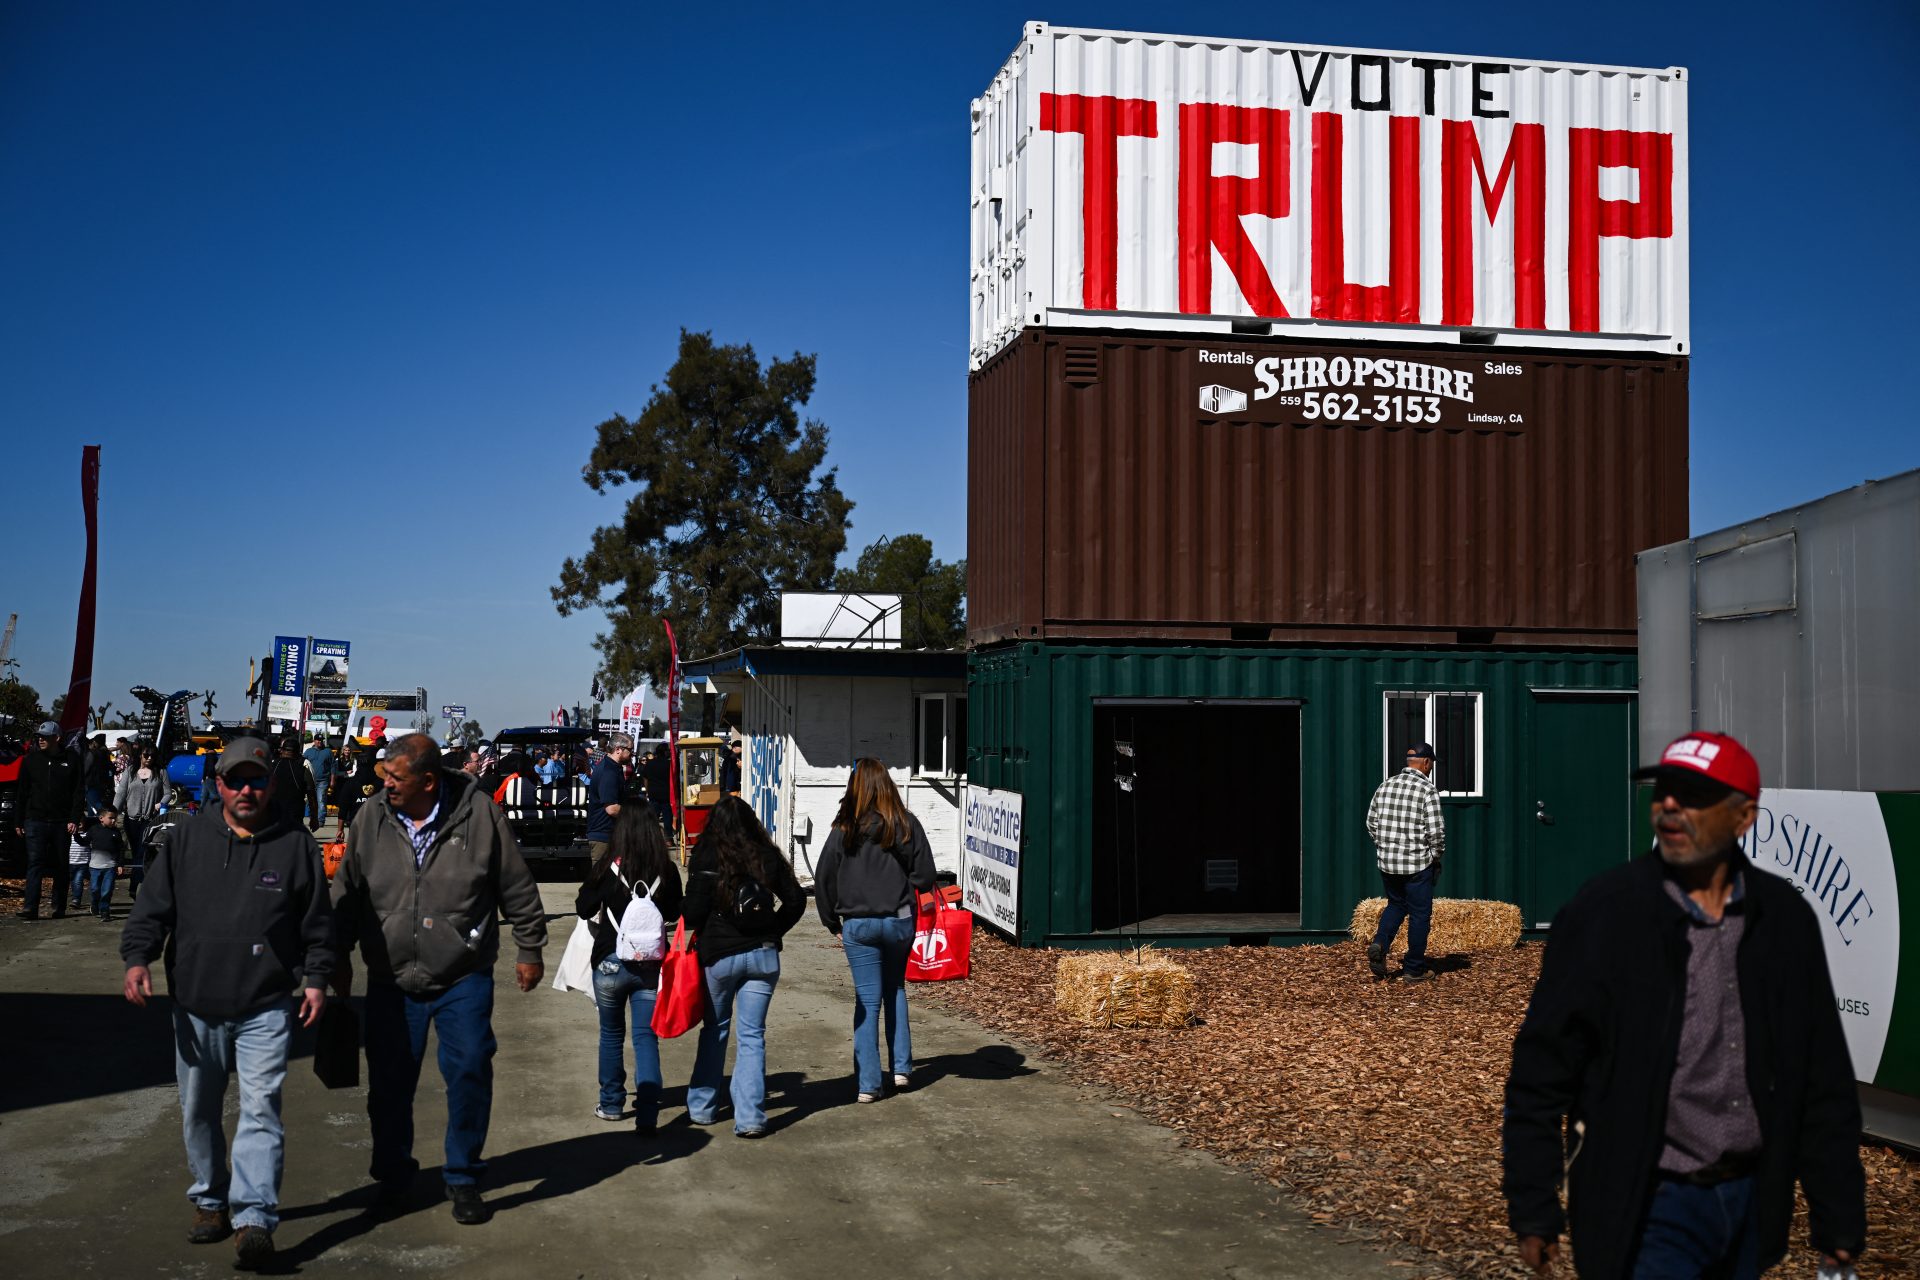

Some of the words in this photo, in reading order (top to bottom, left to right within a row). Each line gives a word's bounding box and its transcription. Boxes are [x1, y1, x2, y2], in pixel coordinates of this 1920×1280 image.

[1290, 50, 1510, 118] VOTE
[1040, 92, 1673, 333] TRUMP
[1199, 350, 1254, 365] Rentals
[1484, 362, 1523, 375] Sales
[1254, 356, 1474, 403] SHROPSHIRE
[1280, 396, 1301, 406] 559
[1302, 392, 1441, 424] 562-3153
[1468, 413, 1506, 425] Lindsay,
[1509, 414, 1523, 424] CA
[284, 644, 299, 692] SPRAYING
[316, 646, 347, 656] SPRAYING
[1738, 807, 1874, 947] PSHIRE
